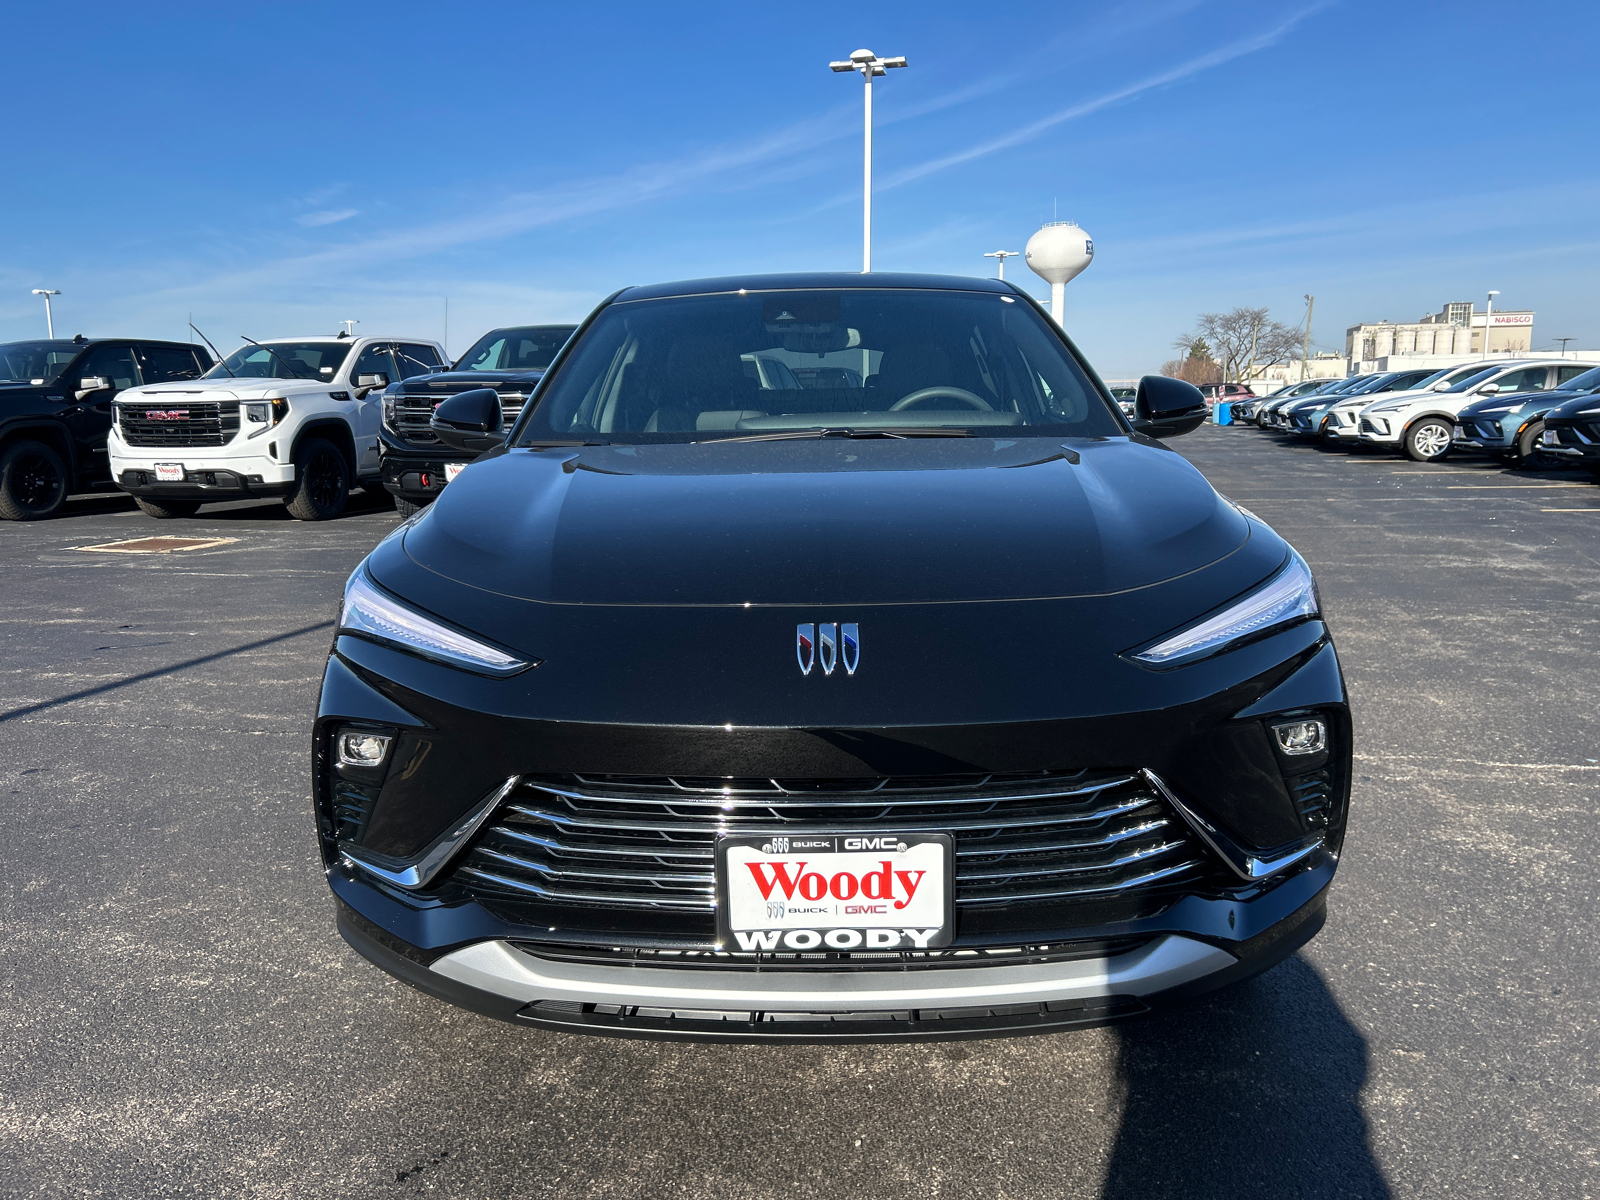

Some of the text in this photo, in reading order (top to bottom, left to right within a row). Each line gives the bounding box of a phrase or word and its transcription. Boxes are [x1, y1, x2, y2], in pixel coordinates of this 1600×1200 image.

[146, 410, 190, 420] GMC
[844, 838, 898, 850] GMC
[744, 861, 927, 910] Woody
[844, 905, 888, 914] GMC
[733, 928, 940, 950] WOODY
